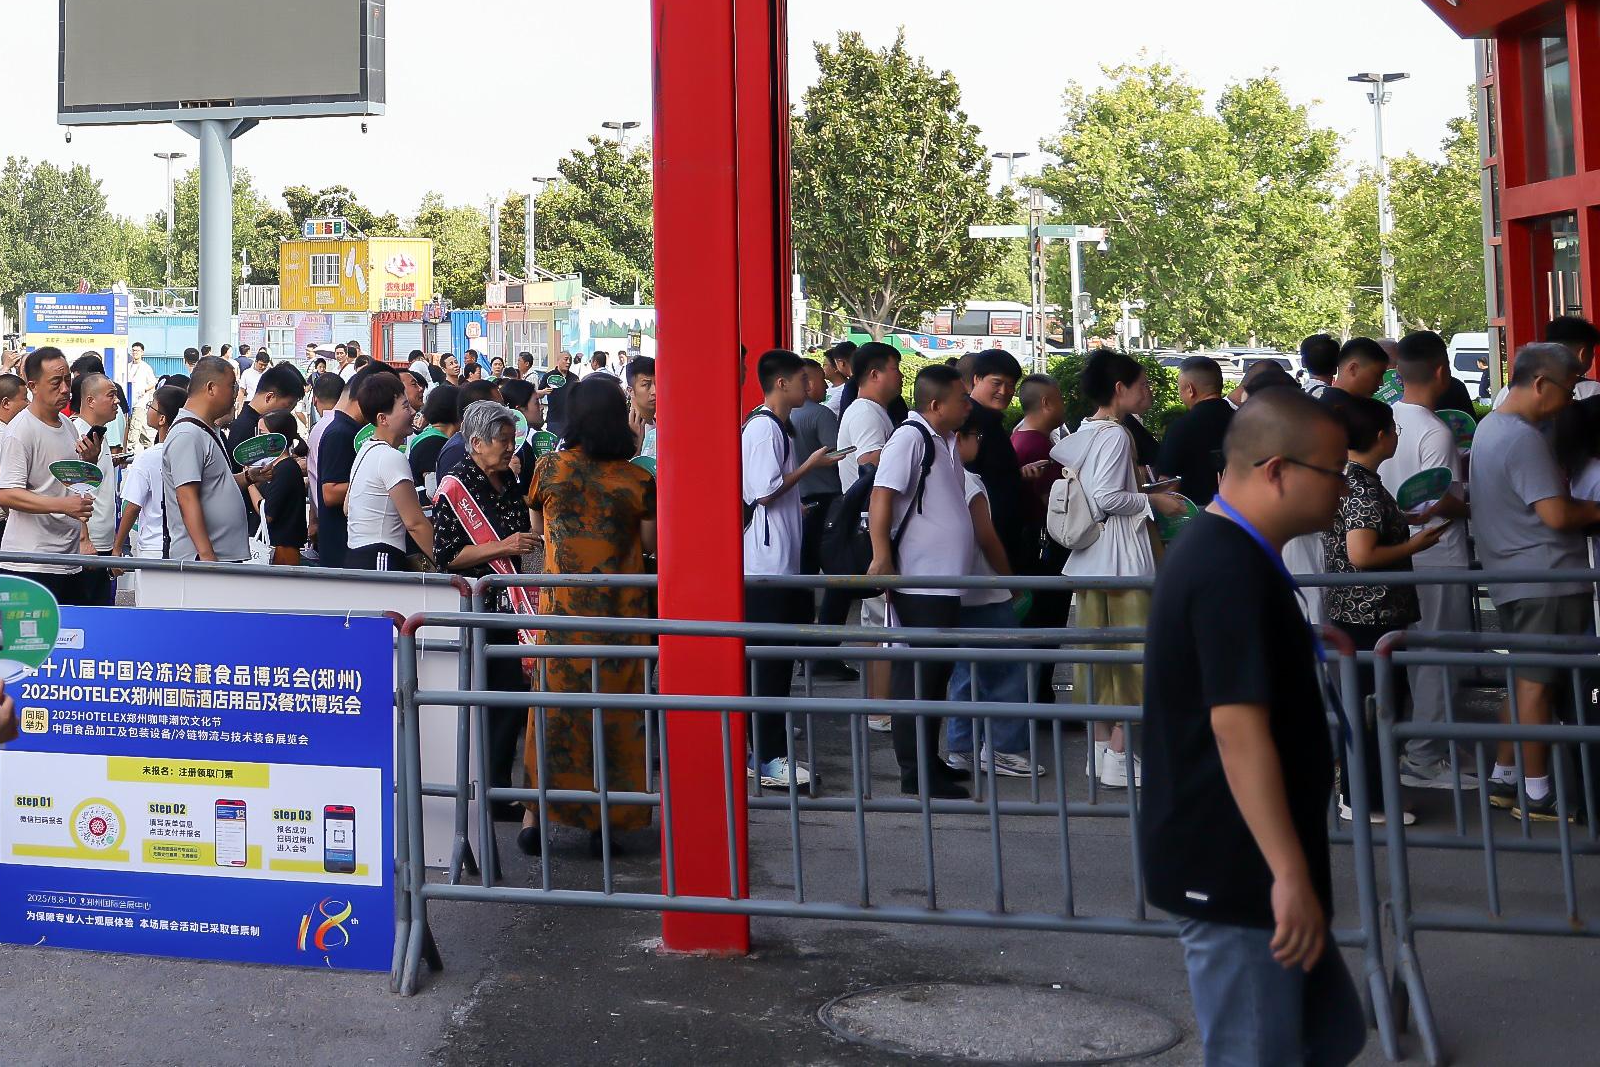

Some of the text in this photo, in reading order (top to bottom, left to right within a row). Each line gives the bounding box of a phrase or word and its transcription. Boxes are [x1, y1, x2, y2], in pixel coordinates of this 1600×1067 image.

[21, 684, 362, 715] 2025HOTELEX郑州国际酒店用品及餐饮博览会
[52, 710, 222, 727] 2025HOTELEX郑州咖啡潮饮文化节
[52, 723, 309, 746] 中国食品加工及包装设备/冷链物流与技术装备展览会
[17, 797, 51, 807] step 01
[150, 804, 186, 815] step 02
[273, 809, 312, 821] step 03
[20, 815, 63, 825] 微信扫码报名
[277, 825, 307, 835] 报名成功
[277, 844, 307, 853] 进入会场
[26, 910, 261, 938] 为保障专业人士观展体验 本场展会活动已采取售票制
